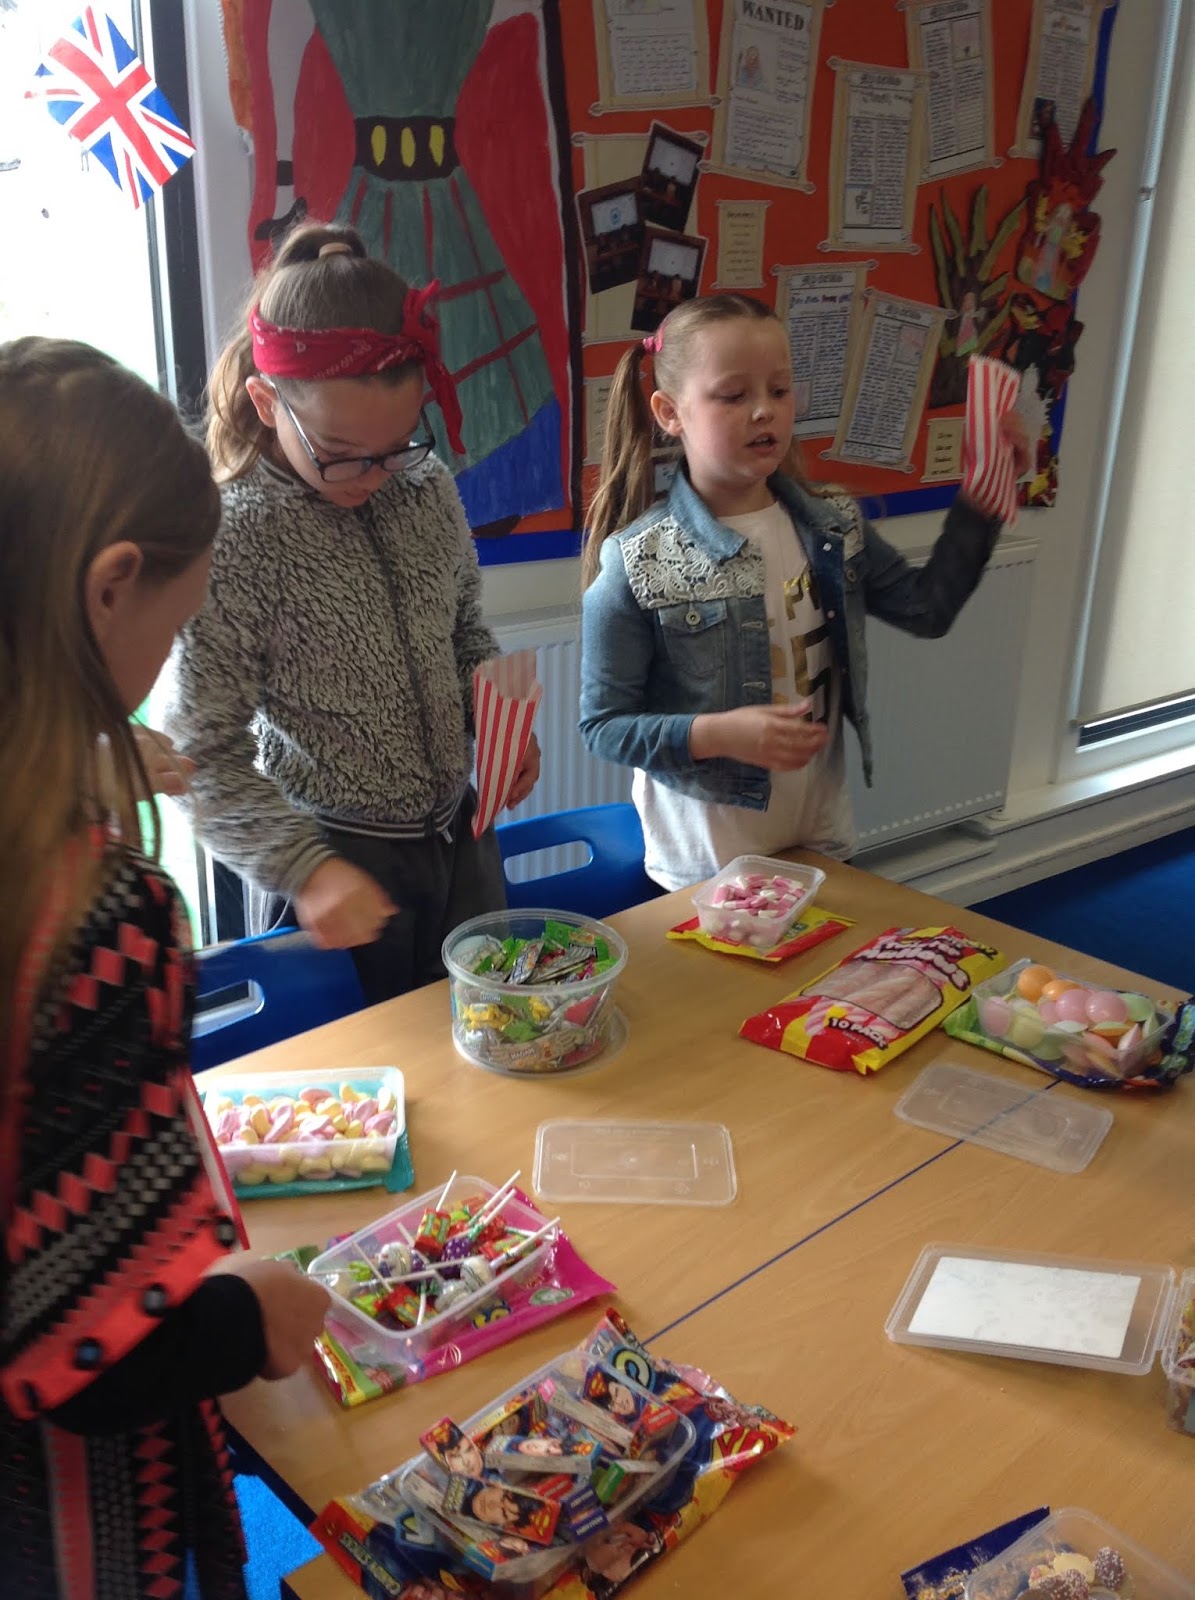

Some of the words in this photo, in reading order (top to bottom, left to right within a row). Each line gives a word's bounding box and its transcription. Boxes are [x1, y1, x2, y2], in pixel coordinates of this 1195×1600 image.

[742, 1, 804, 30] WANTED
[831, 1018, 848, 1030] 10
[850, 1023, 887, 1048] PACK
